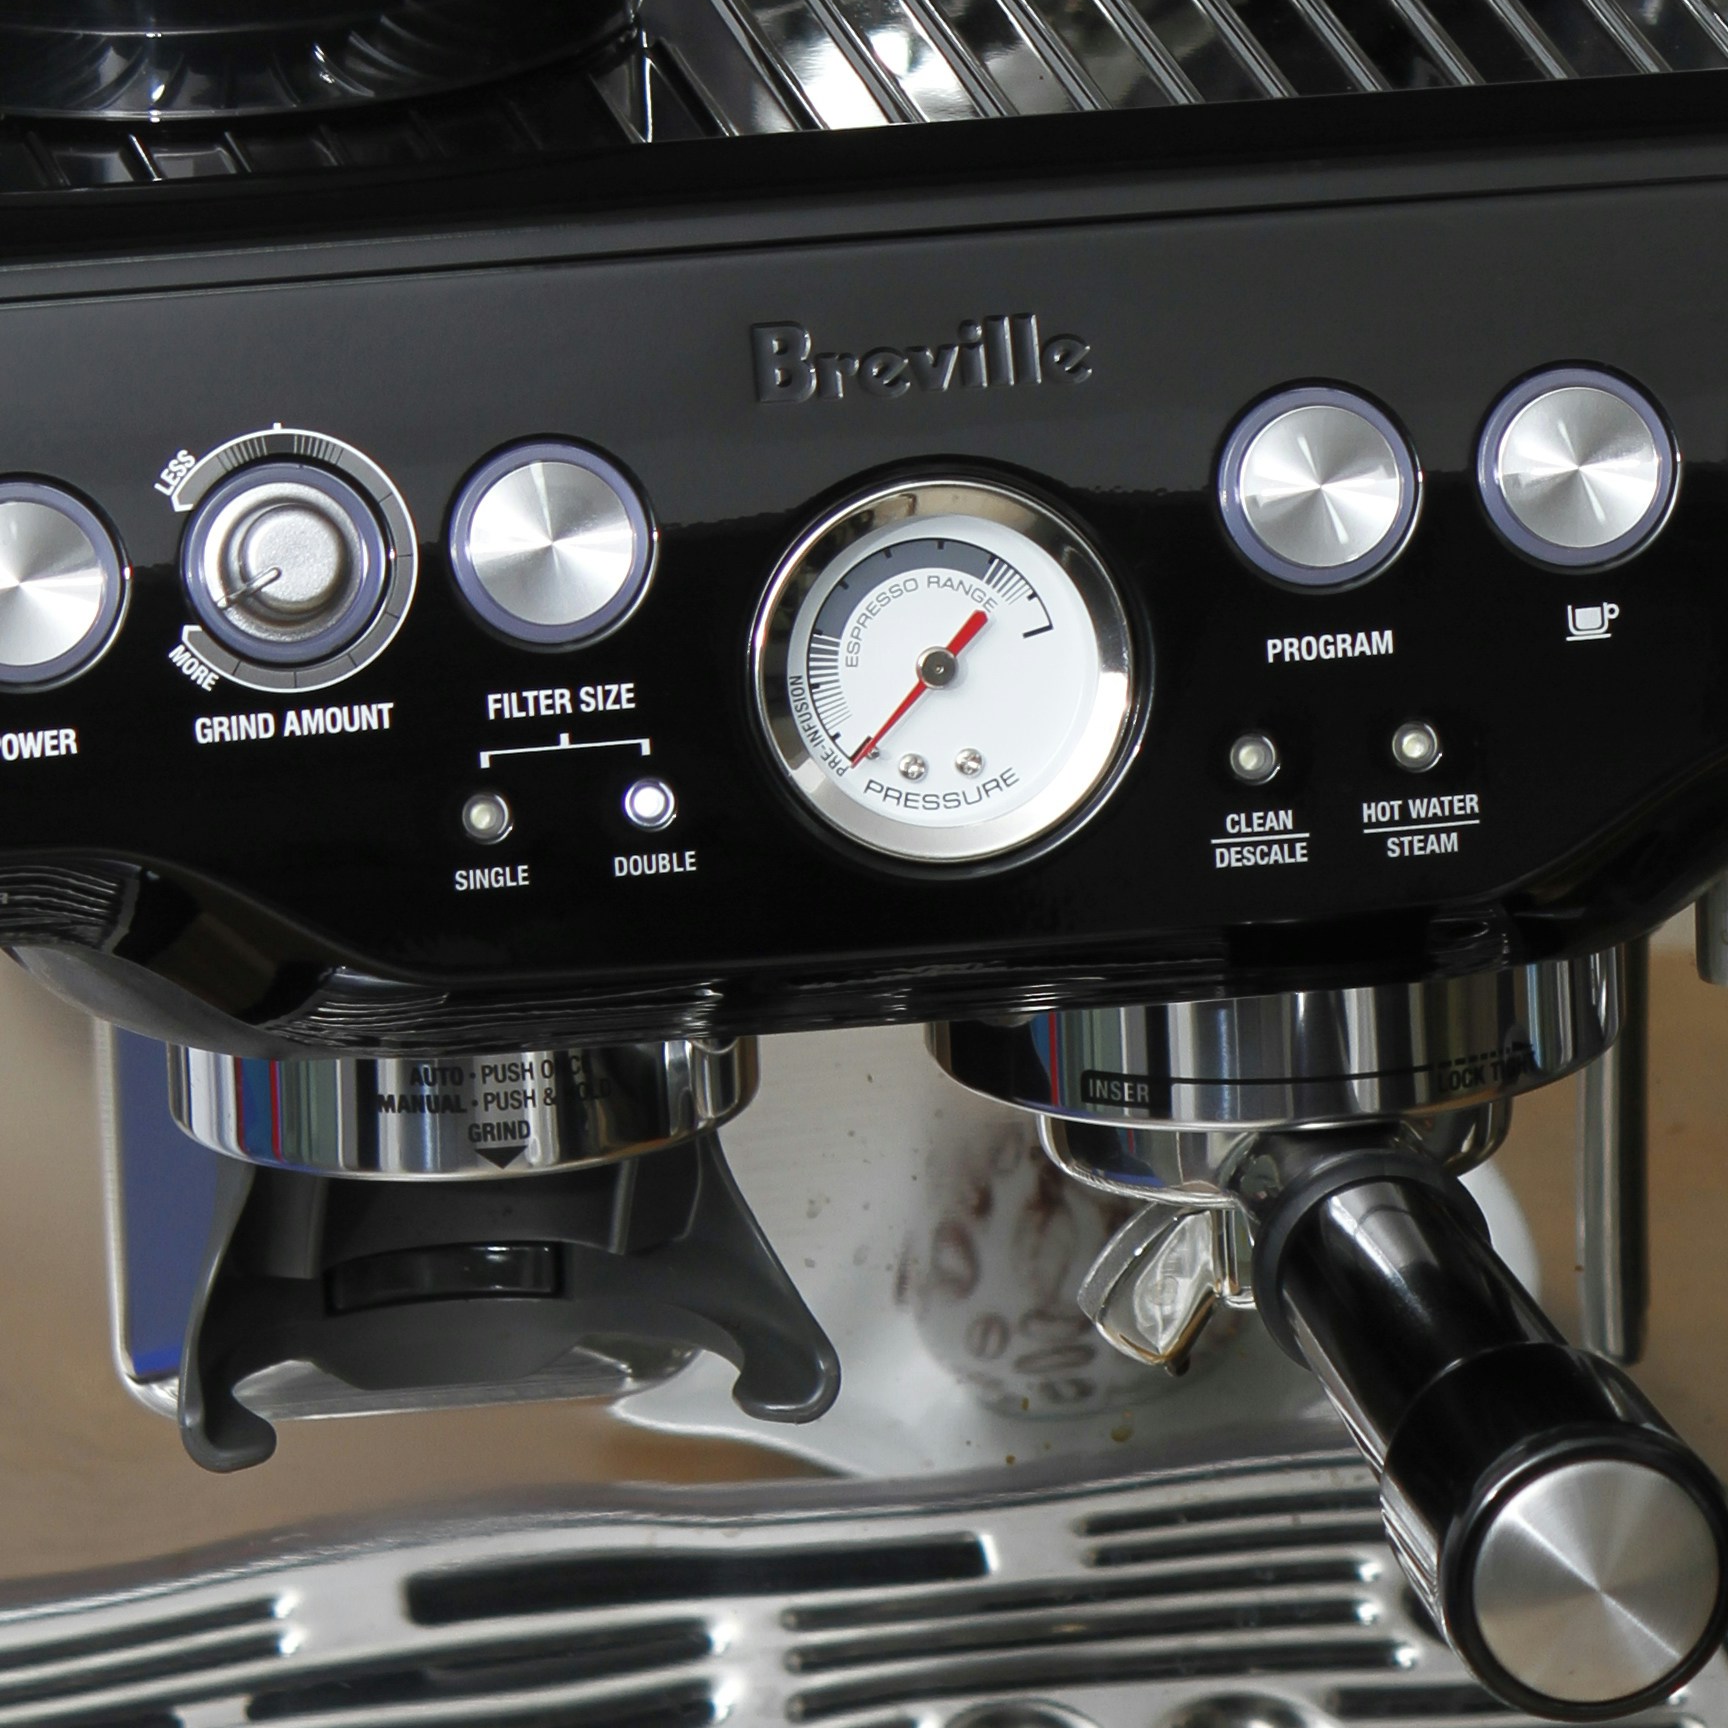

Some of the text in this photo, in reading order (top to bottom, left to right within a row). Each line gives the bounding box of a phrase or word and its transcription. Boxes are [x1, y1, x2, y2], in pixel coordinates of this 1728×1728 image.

[750, 313, 1092, 403] Breville
[154, 449, 196, 496] LESS
[845, 575, 998, 668] ESPRESSO RANGE
[1266, 630, 1394, 663] PROGRAM
[168, 645, 220, 692] MORE
[487, 683, 636, 720] FILTER SIZE
[194, 702, 394, 744] GRIND AMOUNT
[788, 674, 848, 777] PRE-INFUSION
[0, 728, 78, 761] OWER
[864, 767, 1020, 811] PRESSURE
[1225, 809, 1293, 834] CLEAN
[1362, 793, 1480, 823] HOT WATER
[1215, 842, 1309, 868] DESCALE
[1386, 832, 1459, 858] STEAM
[454, 865, 530, 891] SINGLE
[614, 851, 697, 877] DOUBLE
[410, 1066, 464, 1087] AUTO
[481, 1062, 534, 1084] PUSH
[1437, 1065, 1486, 1092] LOCK
[377, 1093, 468, 1114] MANUAL
[483, 1089, 536, 1112] PUSH
[468, 1120, 531, 1144] GRIND
